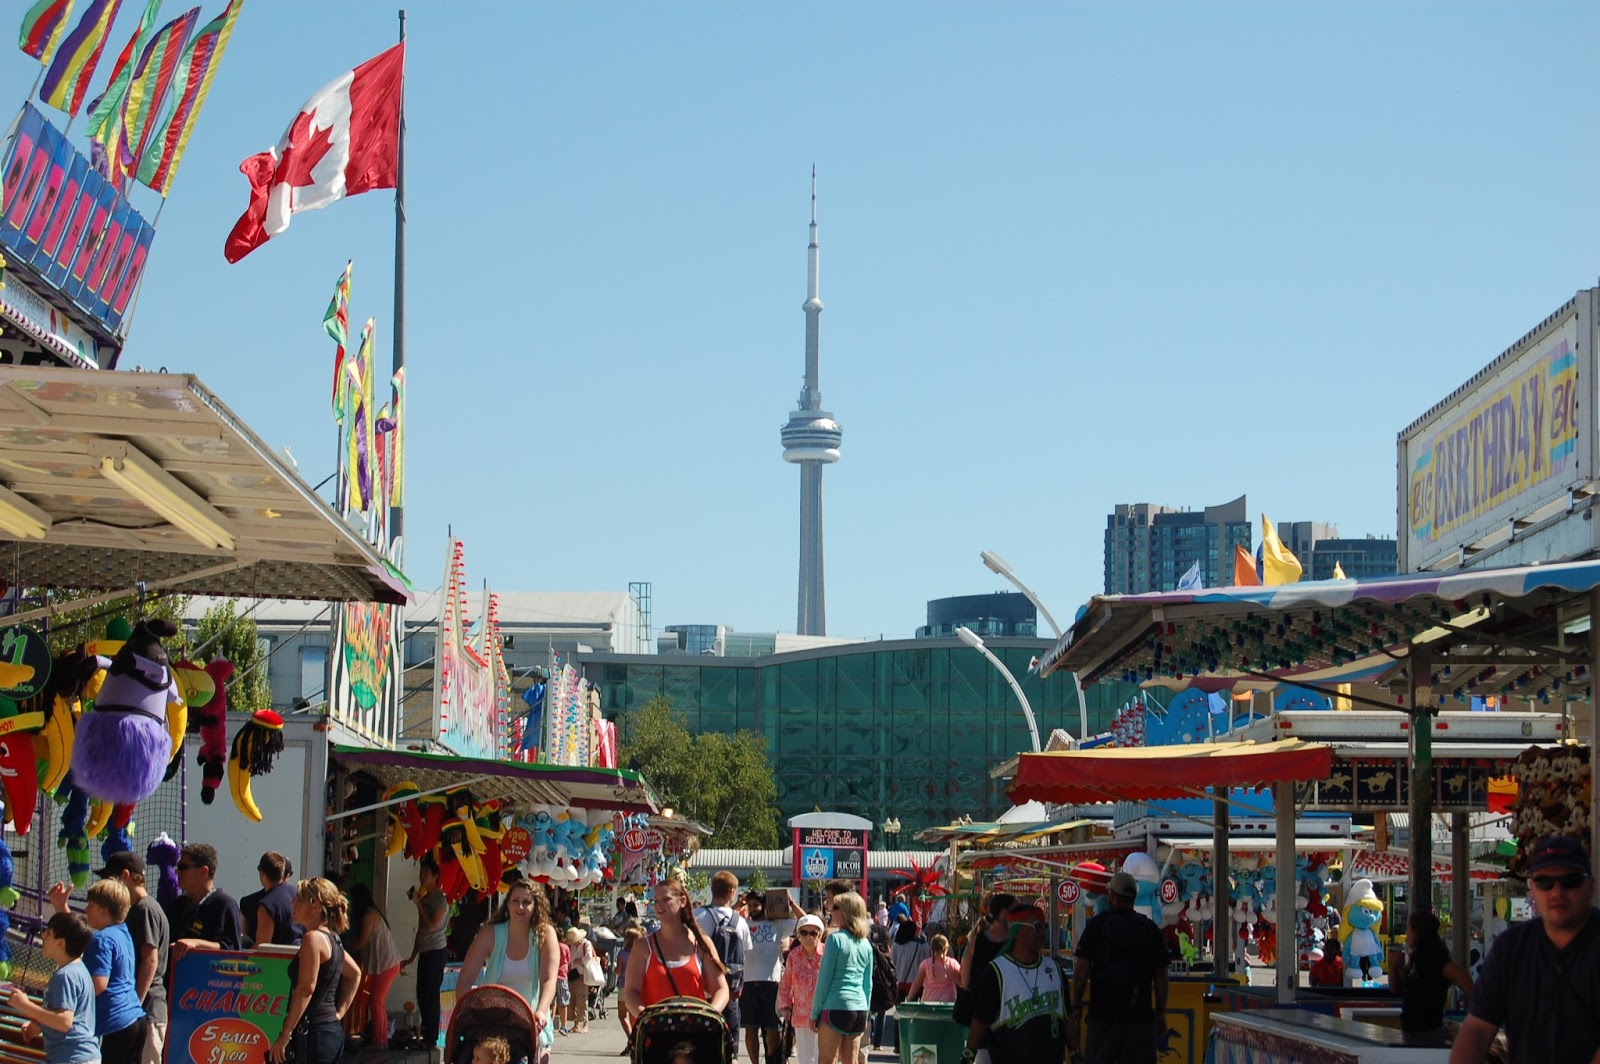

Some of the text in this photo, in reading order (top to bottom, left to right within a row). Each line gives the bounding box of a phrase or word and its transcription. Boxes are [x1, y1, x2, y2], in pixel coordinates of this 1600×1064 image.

[1413, 472, 1432, 525] BIG
[1435, 366, 1546, 530] BIRTHDAY
[2, 628, 28, 666] $1
[0, 720, 16, 732] HOT!
[626, 831, 644, 849] $1.00
[805, 835, 858, 846] RICOH COLISEUM
[811, 829, 852, 838] WELCOME TO
[504, 849, 527, 858] play
[837, 860, 861, 870] RICOH
[757, 924, 773, 933] MY
[179, 988, 288, 1016] CHANGE
[201, 1025, 261, 1045] 5 BALLS
[206, 1044, 248, 1064] $1.00
